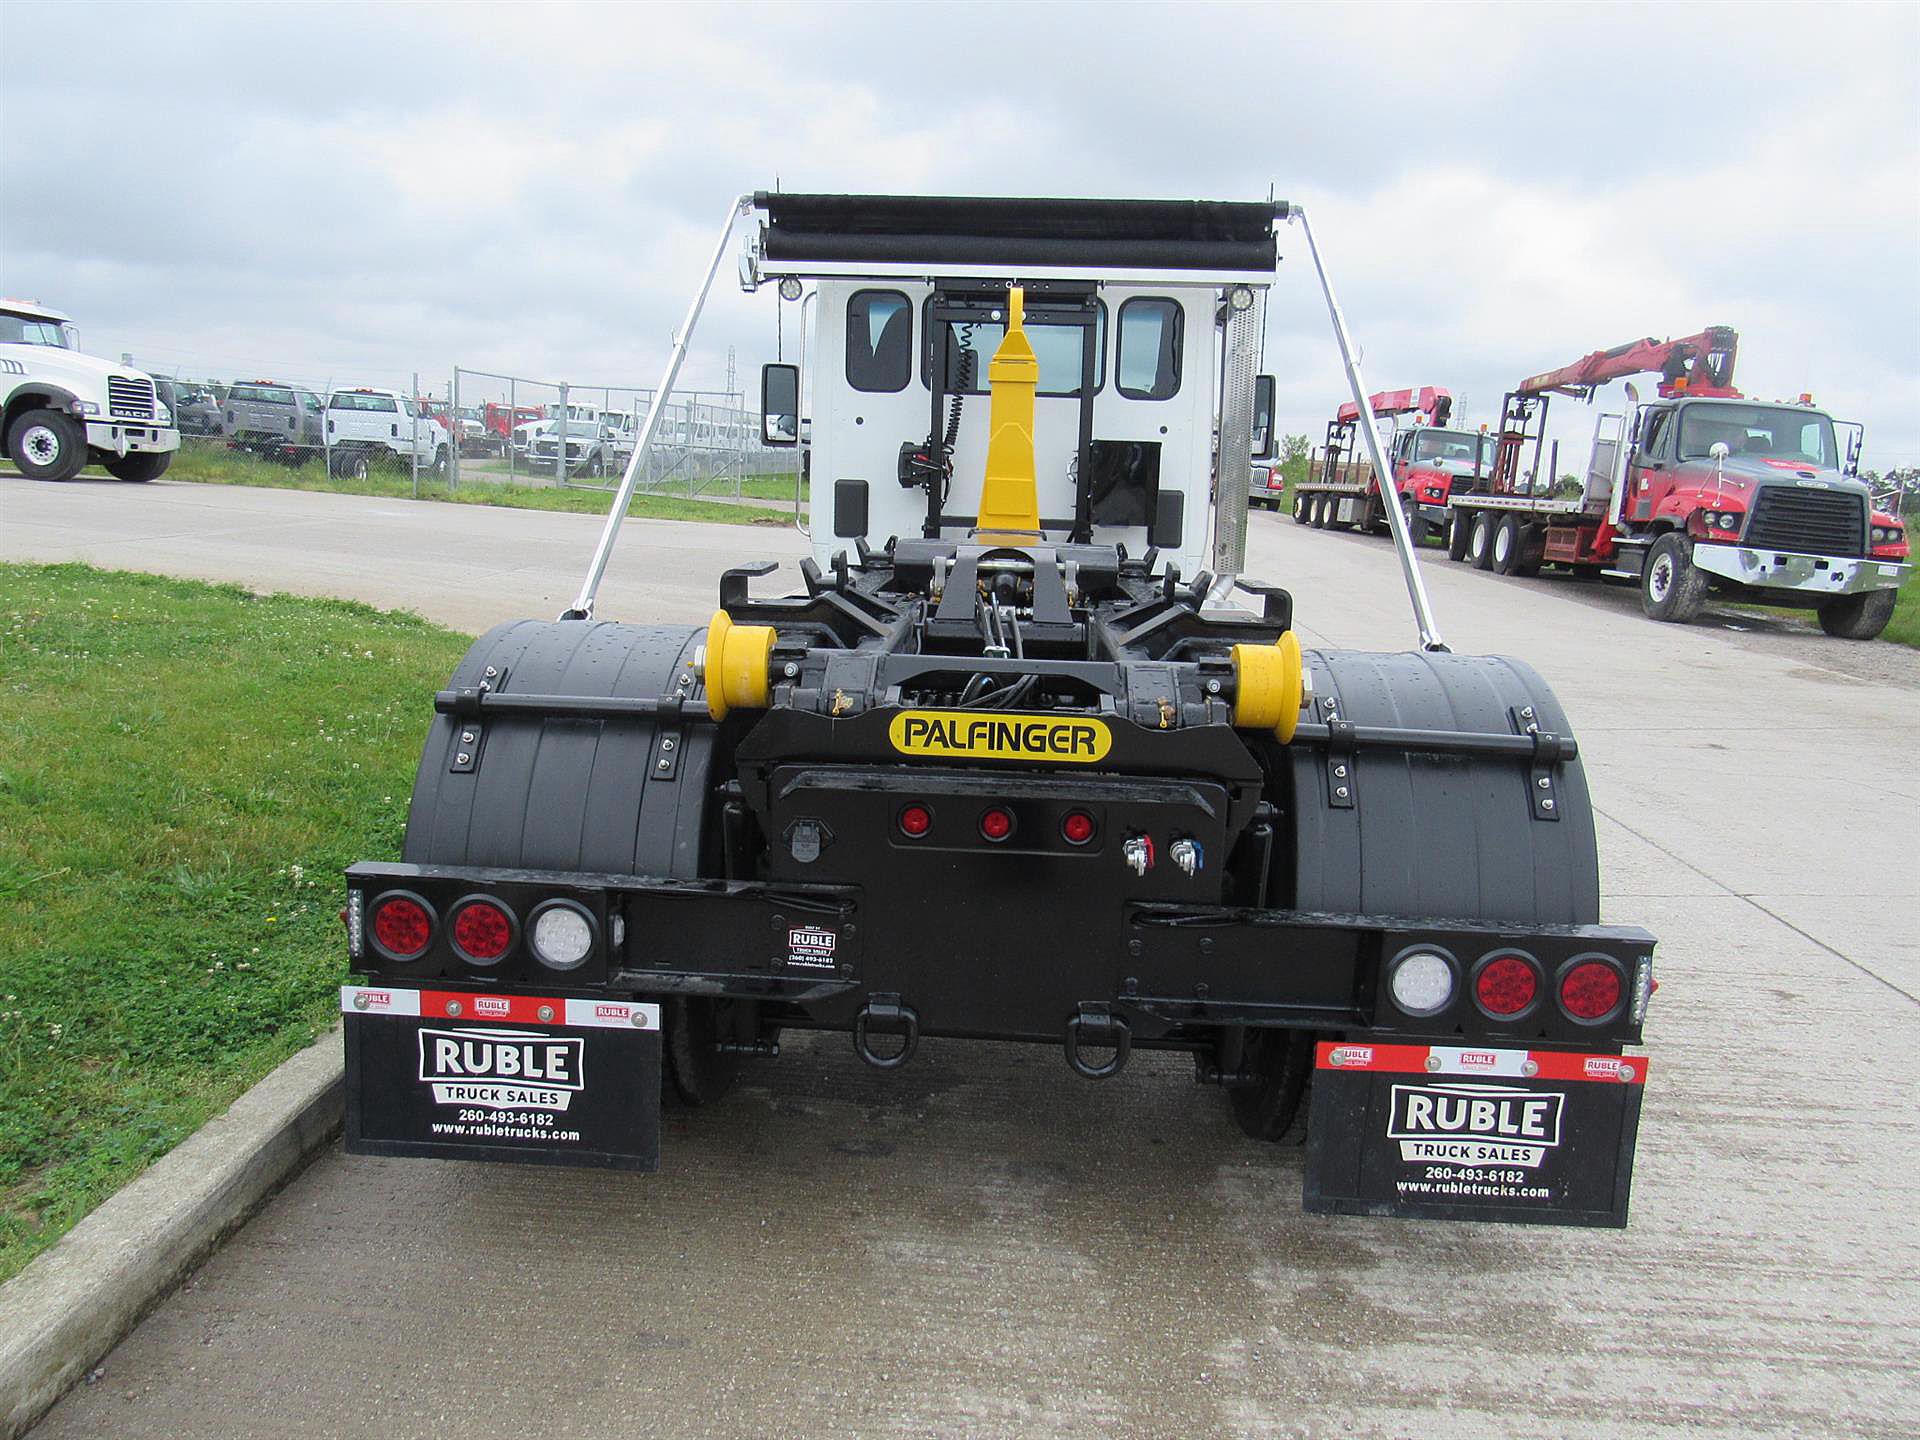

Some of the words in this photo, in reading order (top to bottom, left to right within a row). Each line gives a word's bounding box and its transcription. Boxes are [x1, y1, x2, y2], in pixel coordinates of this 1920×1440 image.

[113, 409, 150, 418] MACK
[904, 718, 1095, 755] PALFINGER
[793, 933, 832, 947] RUBLE
[363, 993, 389, 1004] UBLE
[478, 1001, 507, 1010] RUBLE
[597, 1007, 628, 1017] RUBLE
[436, 1038, 569, 1080] RUBLE
[1341, 1050, 1369, 1059] UBLE
[1462, 1054, 1494, 1064] RUBLE
[1587, 1061, 1618, 1070] RUBLE
[445, 1086, 499, 1101] TRUCK
[507, 1090, 559, 1105] SALES
[459, 1109, 554, 1126] 260-493-6182
[1406, 1094, 1548, 1136] RUBLE
[432, 1123, 580, 1141] www.rubletrucks.com
[1413, 1143, 1471, 1159] TRUCK
[1477, 1146, 1532, 1161] SALES
[1425, 1166, 1525, 1183] 260-493-6182
[1396, 1180, 1549, 1198] www.rubletrucks.com
